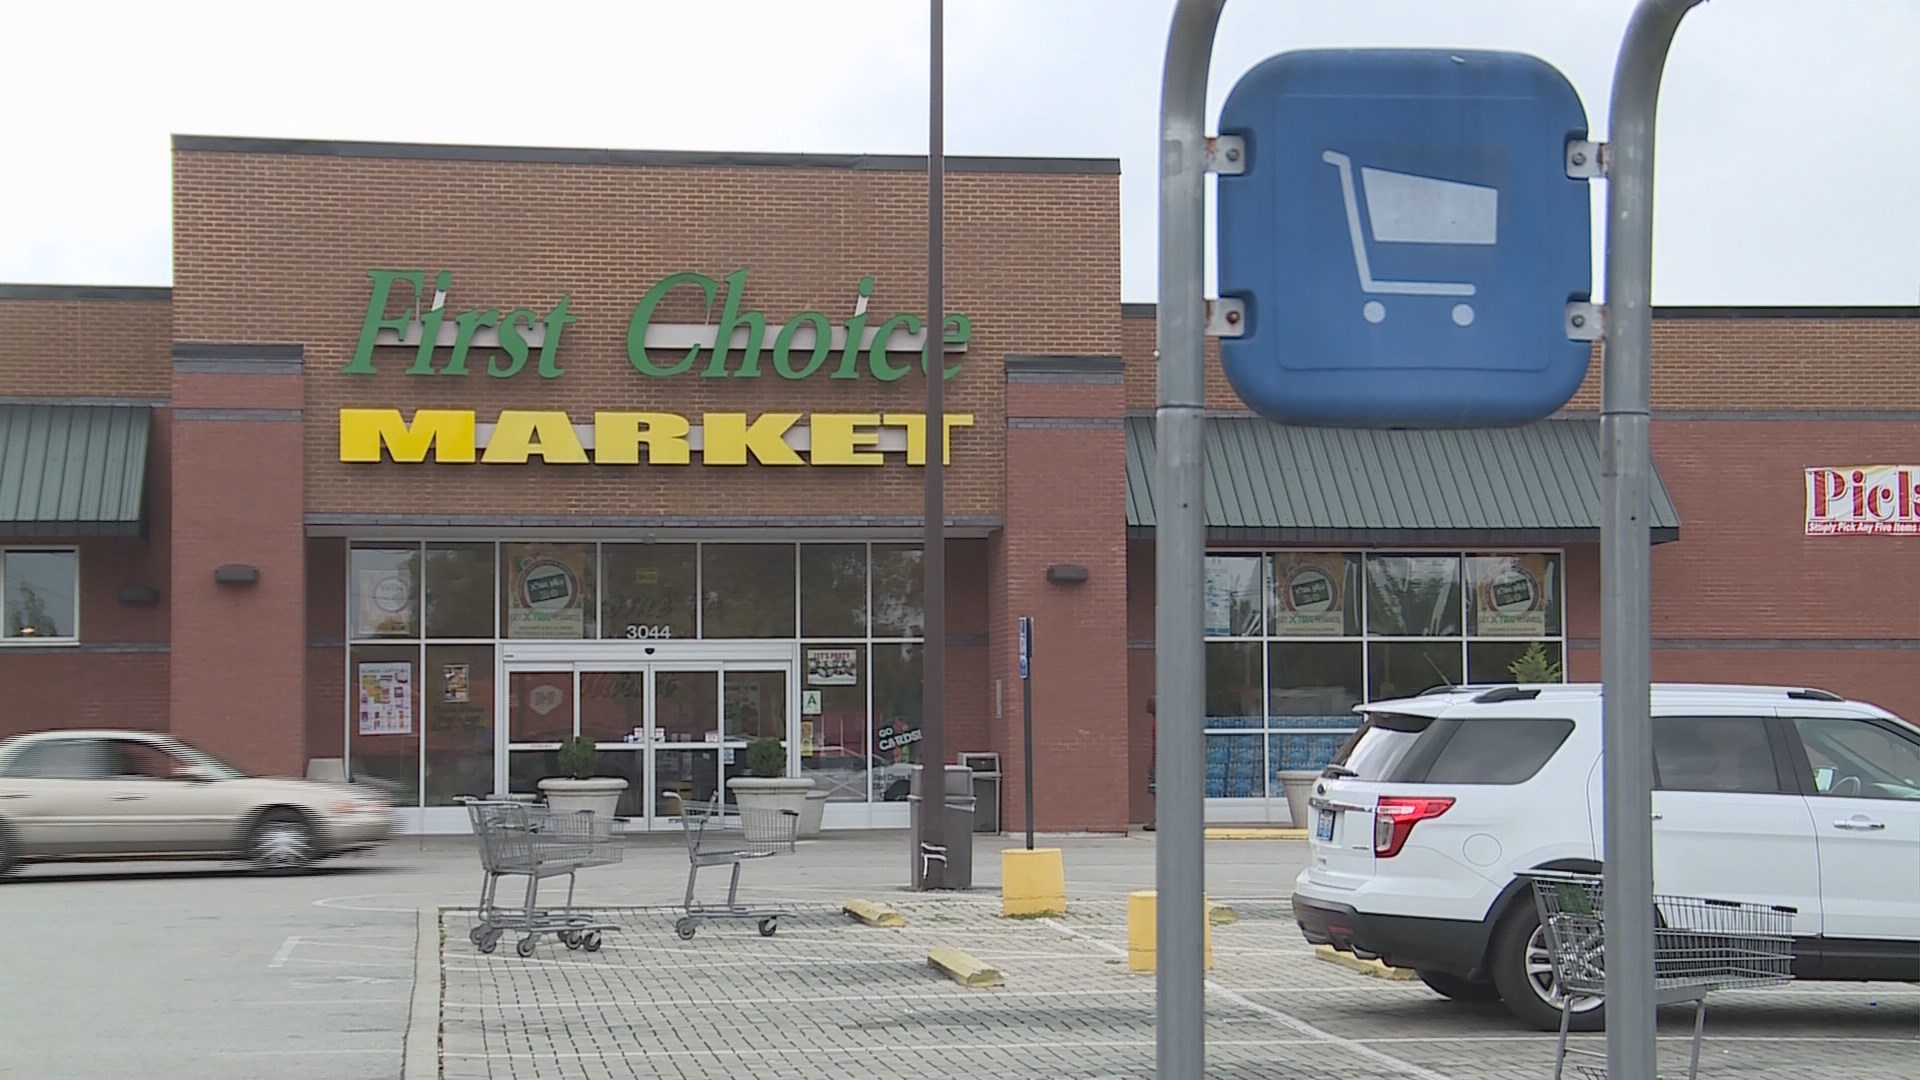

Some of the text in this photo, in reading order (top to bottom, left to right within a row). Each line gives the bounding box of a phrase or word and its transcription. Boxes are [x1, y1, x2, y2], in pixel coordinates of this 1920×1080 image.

[342, 267, 973, 381] First Choice
[339, 408, 974, 466] MARKET
[626, 625, 671, 639] 3044
[807, 695, 817, 705] A
[879, 727, 893, 738] GO
